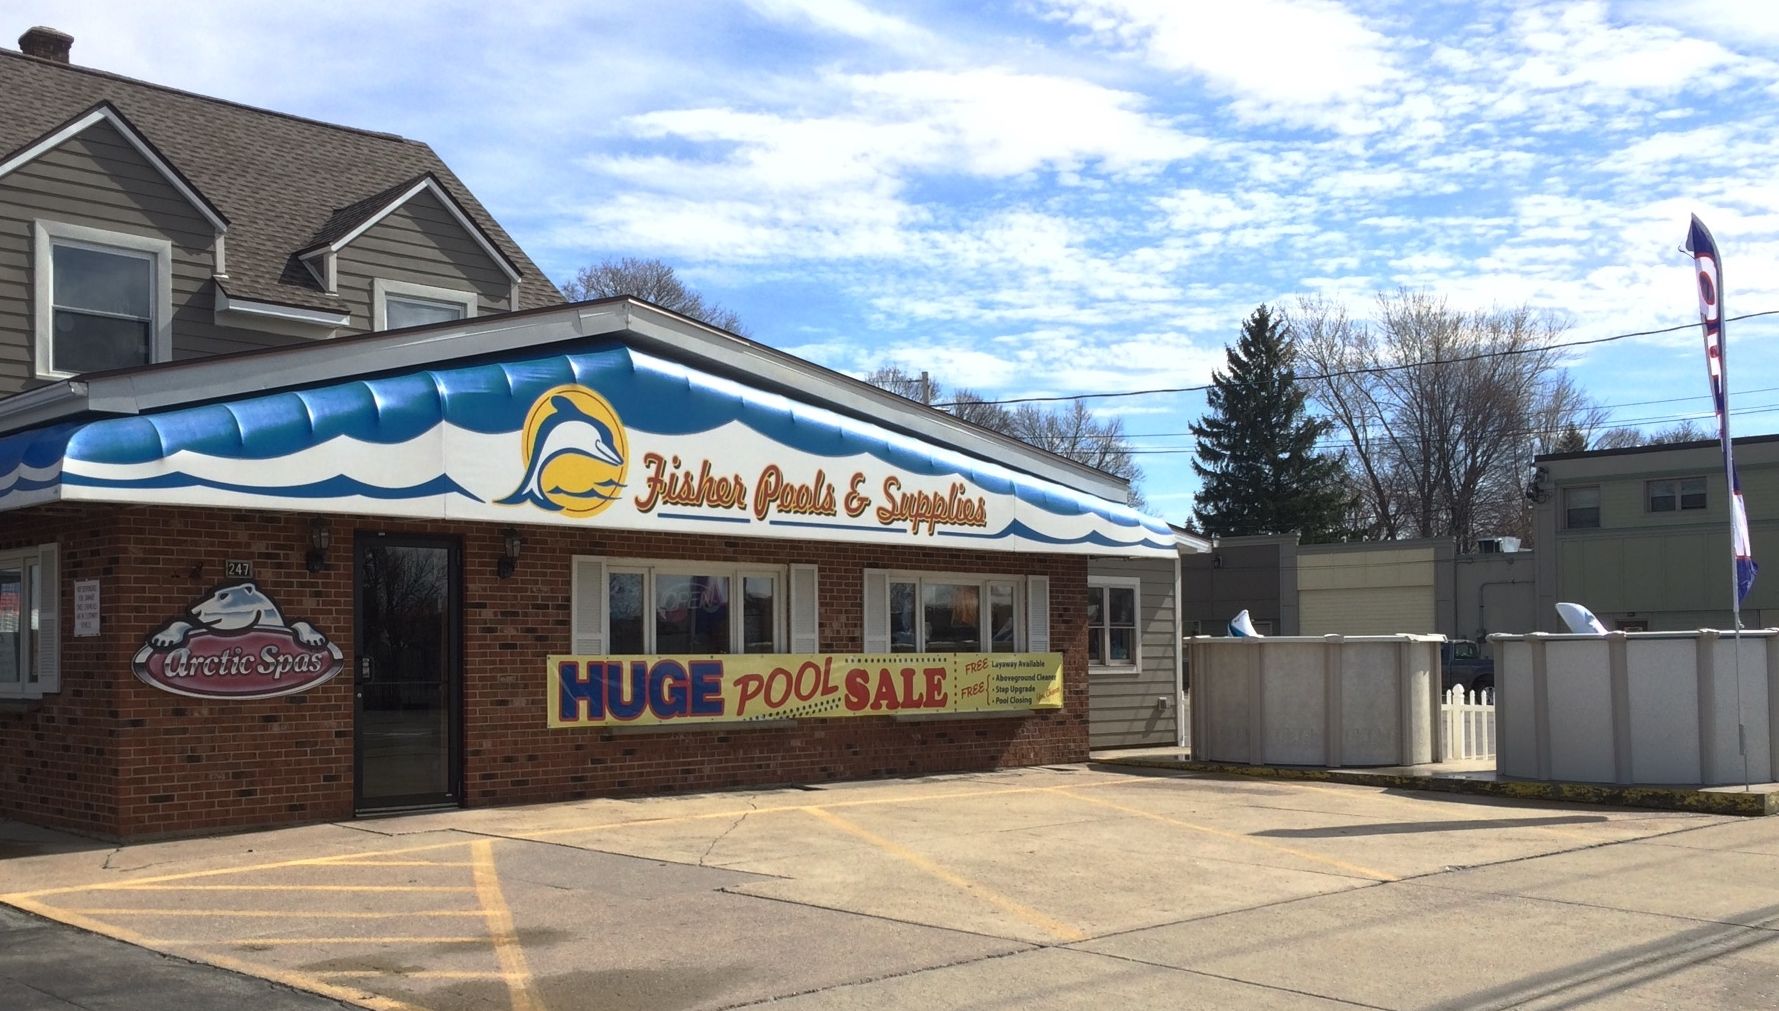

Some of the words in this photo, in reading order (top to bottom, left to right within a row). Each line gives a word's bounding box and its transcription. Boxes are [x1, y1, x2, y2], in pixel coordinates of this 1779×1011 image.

[634, 452, 747, 512] Fisher
[754, 464, 837, 521] Pools
[844, 471, 871, 514] &
[876, 475, 987, 535] Supplies
[228, 563, 249, 576] 247
[257, 645, 323, 679] Spas
[965, 658, 989, 675] FREE
[991, 660, 1018, 669] Layaway
[1018, 660, 1045, 668] Available
[995, 674, 1035, 682] Aboveground
[559, 659, 724, 722] HUGE
[733, 656, 839, 716] POOL
[844, 667, 948, 711] SALE
[961, 681, 985, 699] FREE
[1010, 684, 1035, 694] Upgrade
[1010, 696, 1032, 705] Closing
